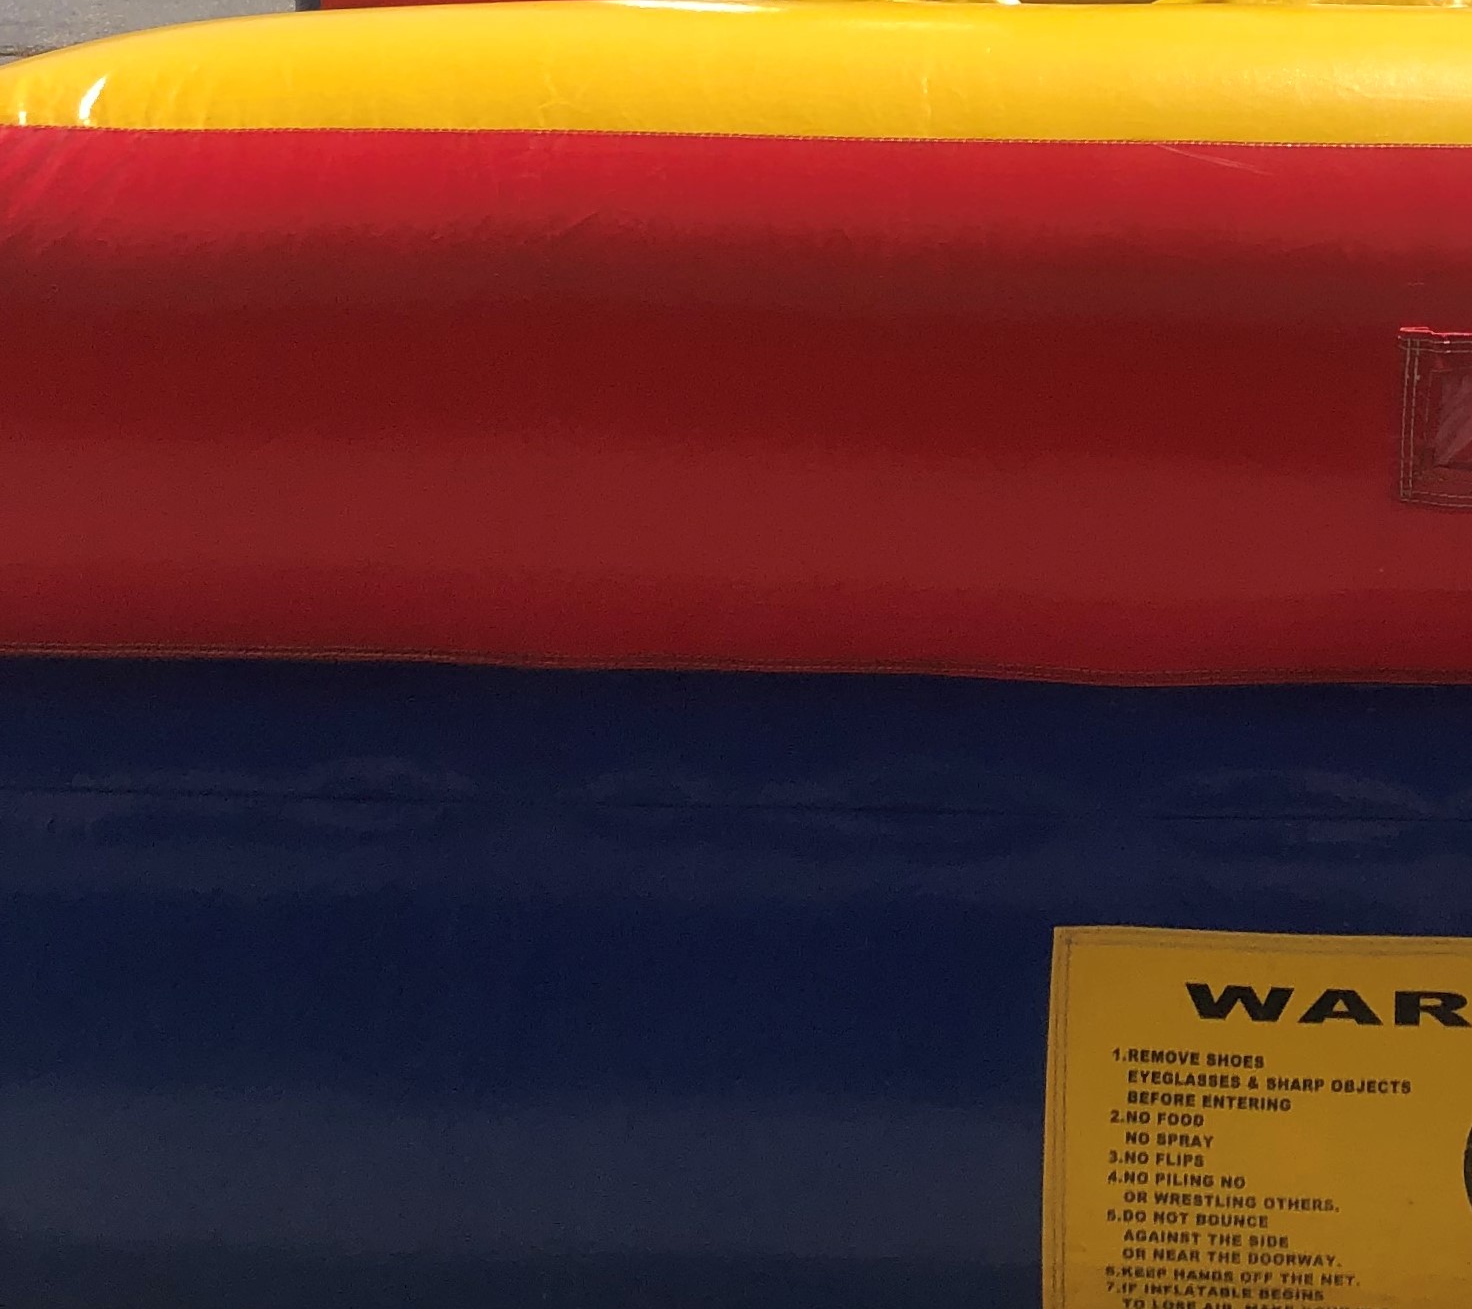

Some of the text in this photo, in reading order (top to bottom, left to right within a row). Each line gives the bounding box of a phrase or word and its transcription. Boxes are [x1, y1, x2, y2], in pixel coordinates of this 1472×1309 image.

[1112, 1048, 1264, 1069] 1.REMOVE SHOES
[1127, 1070, 1411, 1094] EYEGLASSES & SHARP OBJECTS
[1127, 1090, 1291, 1111] BEFORE ENTERING
[1110, 1109, 1204, 1127] 2.NO FOOD
[1125, 1132, 1214, 1148] NO SPRAY
[1109, 1150, 1204, 1167] 3.NO FLIPS
[1108, 1171, 1246, 1188] 4.NO PILING NO
[1123, 1191, 1340, 1213] OR WRESTLING OTHERS.
[1107, 1209, 1268, 1228] 5.DO NOT BOUNCE
[1123, 1229, 1289, 1249] AGAINST THE SIDE
[1122, 1248, 1343, 1268] OR NEAR THE DOORWAY.
[1174, 1268, 1233, 1282] HANDS
[1240, 1271, 1273, 1284] OFF
[1280, 1272, 1313, 1286] THE
[1320, 1274, 1361, 1287] NET.
[1144, 1283, 1252, 1299] INFLATABLE
[1258, 1287, 1325, 1301] BEGINS
